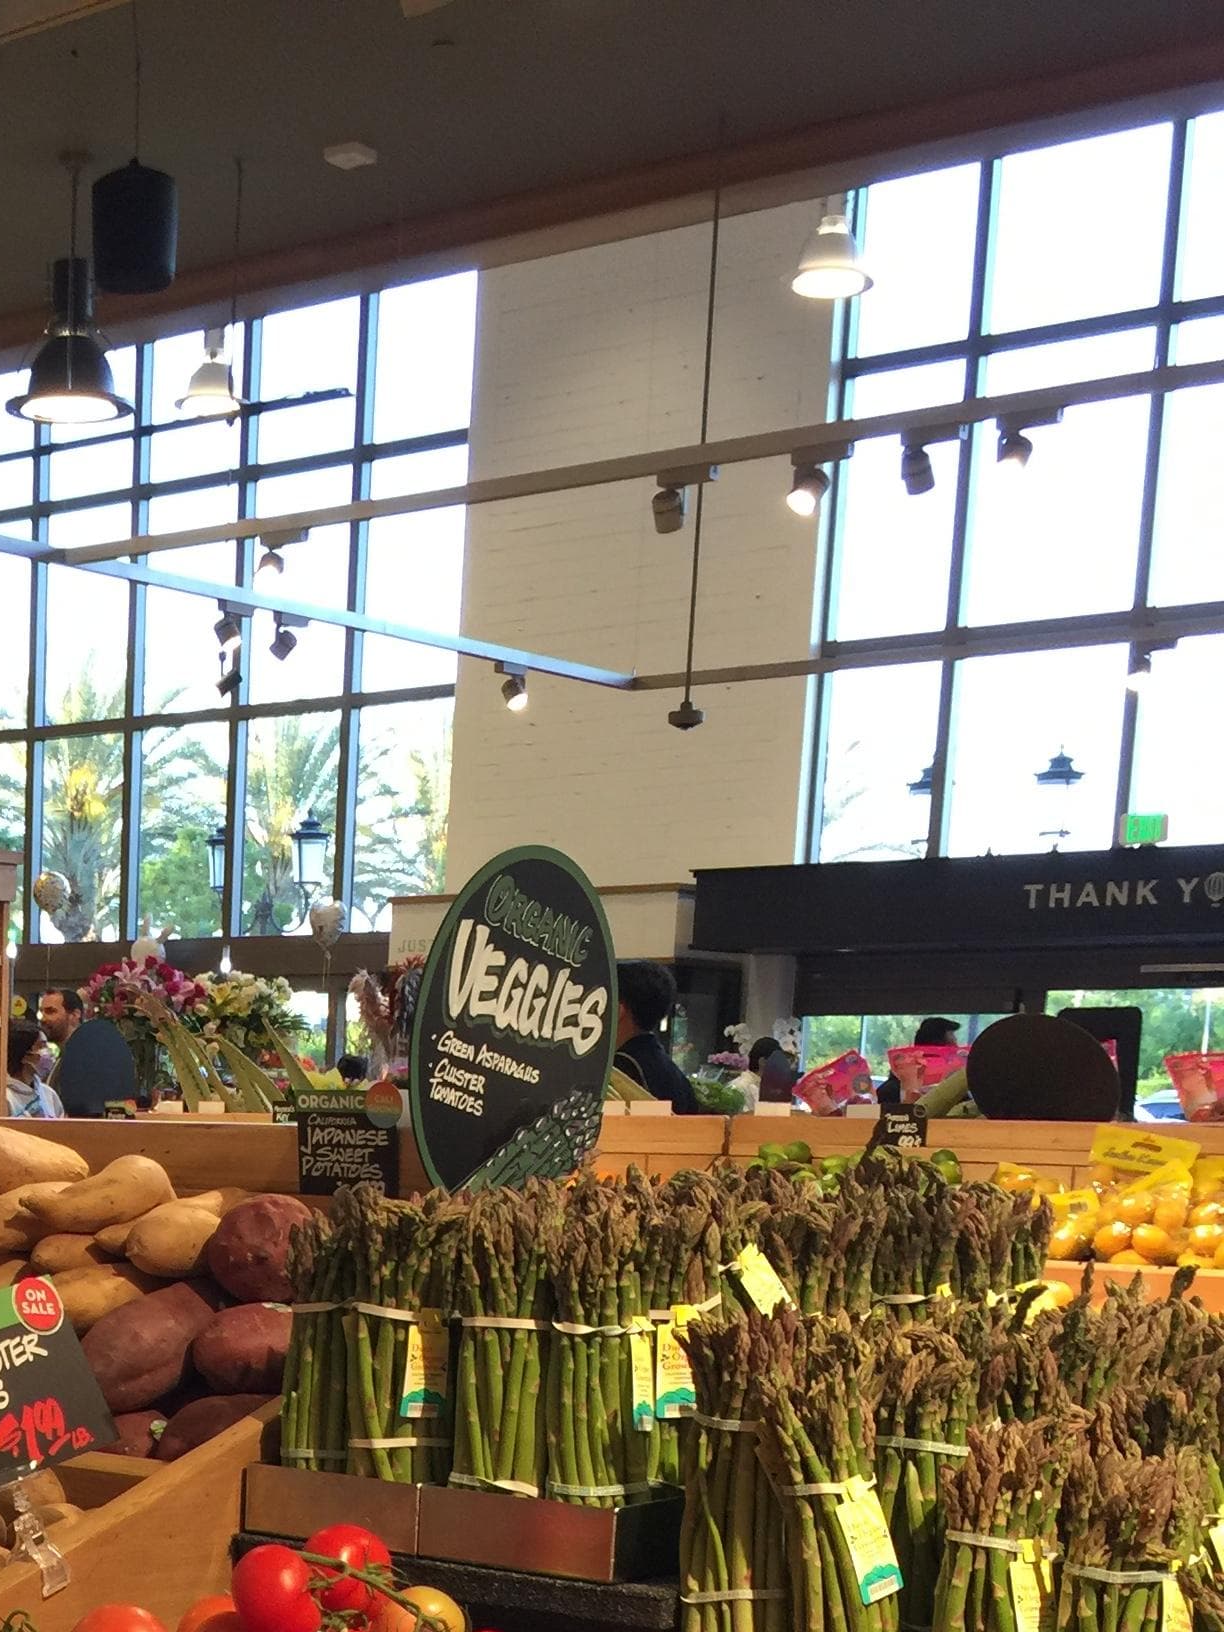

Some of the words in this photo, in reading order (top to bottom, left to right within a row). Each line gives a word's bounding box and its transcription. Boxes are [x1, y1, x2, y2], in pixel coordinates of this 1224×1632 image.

[1024, 879, 1160, 910] THANK
[484, 874, 594, 968] ORGANIC
[446, 918, 608, 1056] VEGGIES
[437, 1031, 475, 1062] GREEN
[476, 1044, 540, 1084] ASPARAGUS
[434, 1059, 485, 1094] CLUSTER
[298, 1094, 365, 1109] ORGANIC
[429, 1077, 484, 1117] TOMATOES
[300, 1127, 389, 1154] JAPANESE
[316, 1147, 375, 1162] SWEET
[302, 1156, 383, 1179] POTATOES
[21, 1302, 56, 1316] SALE
[25, 1288, 47, 1302] ON
